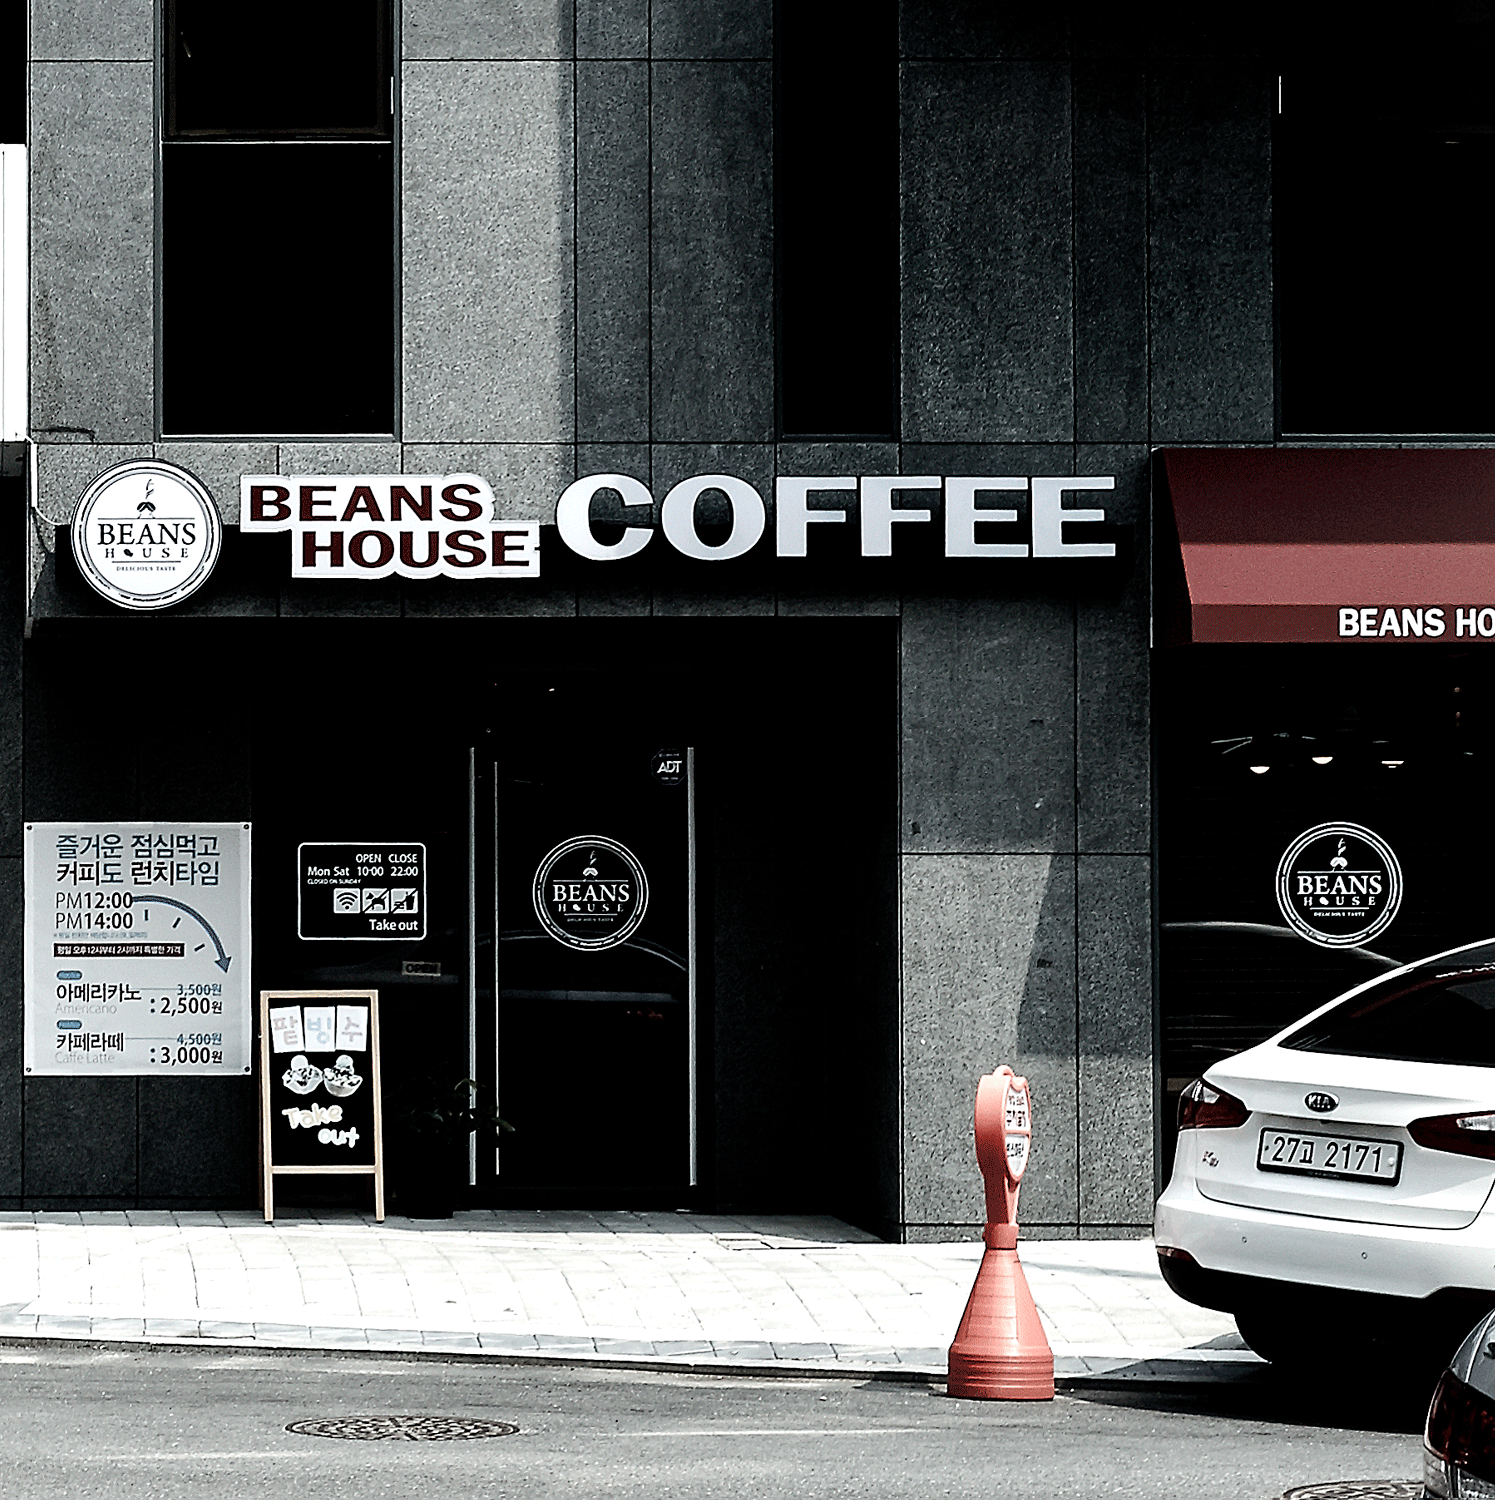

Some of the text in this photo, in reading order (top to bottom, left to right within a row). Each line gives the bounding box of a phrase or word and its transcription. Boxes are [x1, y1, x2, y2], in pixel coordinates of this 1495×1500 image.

[249, 482, 484, 523] BEANS
[556, 472, 1117, 562] COFFEE
[97, 522, 196, 547] BEANS
[301, 529, 531, 569] HOUSE
[1338, 607, 1446, 638] BEANS
[656, 760, 683, 774] ADT
[55, 833, 221, 859] 즐거운 점심먹고
[355, 853, 418, 863] OPEN CLOSE
[56, 860, 220, 886] 커피도 런치타임
[307, 866, 331, 876] Mon
[333, 866, 350, 876] Sat
[390, 866, 419, 876] 22:00
[552, 884, 630, 902] BEANS
[1296, 875, 1382, 895] BEANS
[55, 891, 134, 909] PM12:00
[55, 912, 134, 930] PM14:00
[368, 918, 419, 931] Take out
[56, 982, 222, 1002] 아메리카노 3,500원
[54, 1002, 118, 1014] Americano
[56, 1032, 222, 1052] 카페라떼 4,500원
[85, 1051, 116, 1065] Latte
[1307, 1093, 1332, 1110] KIA
[281, 1102, 343, 1130] Take
[317, 1126, 360, 1149] out
[1271, 1135, 1382, 1173] 27고 2171
